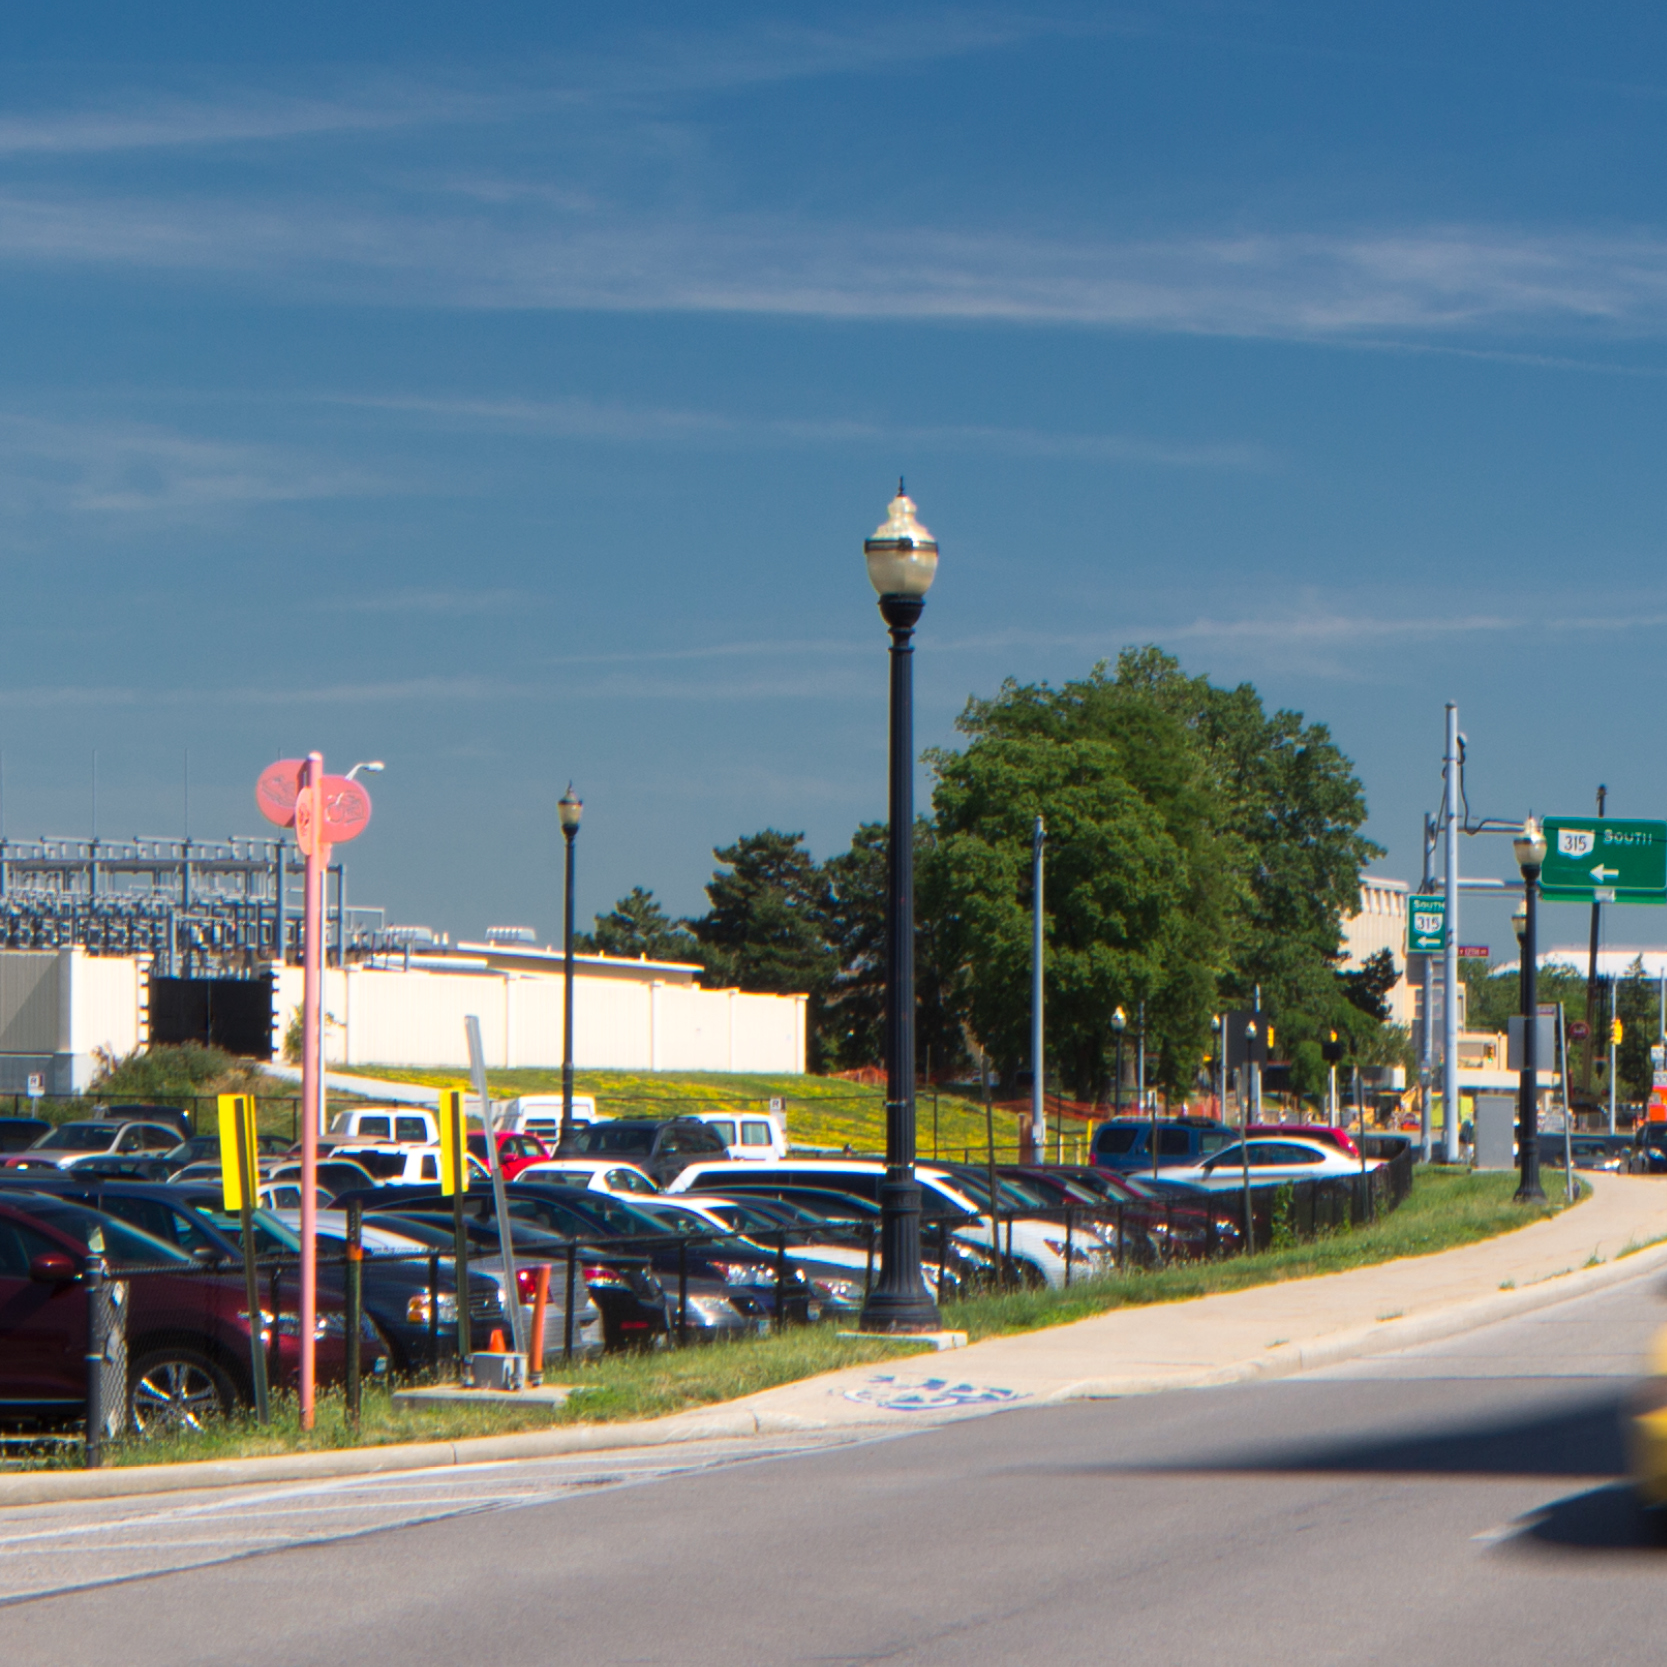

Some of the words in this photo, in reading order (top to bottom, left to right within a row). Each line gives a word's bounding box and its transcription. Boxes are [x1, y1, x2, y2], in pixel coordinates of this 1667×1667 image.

[1564, 835, 1587, 852] 315
[1603, 828, 1652, 845] SOUTH
[1413, 899, 1445, 910] SOUTH
[1416, 916, 1440, 931] 315
